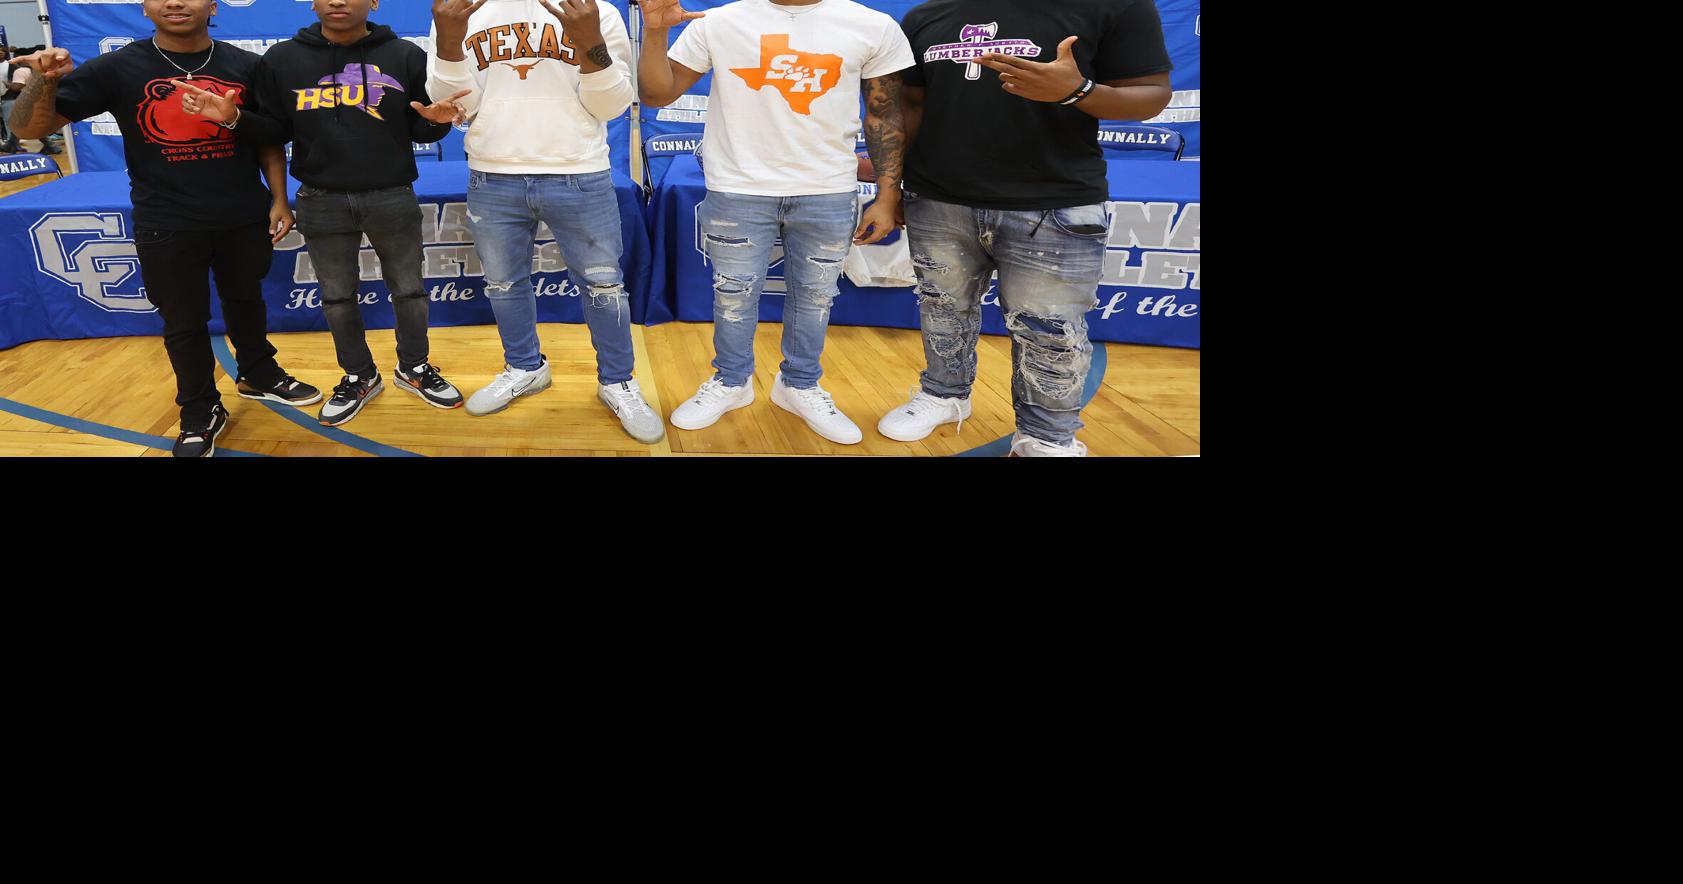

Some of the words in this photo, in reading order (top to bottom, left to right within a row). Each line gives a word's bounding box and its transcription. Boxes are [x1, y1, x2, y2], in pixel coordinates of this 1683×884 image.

[465, 22, 580, 71] TEXAS
[294, 84, 364, 111] HSU
[161, 147, 194, 155] CROSS
[166, 154, 199, 162] TRACK
[430, 281, 475, 302] the
[1136, 294, 1198, 318] the
